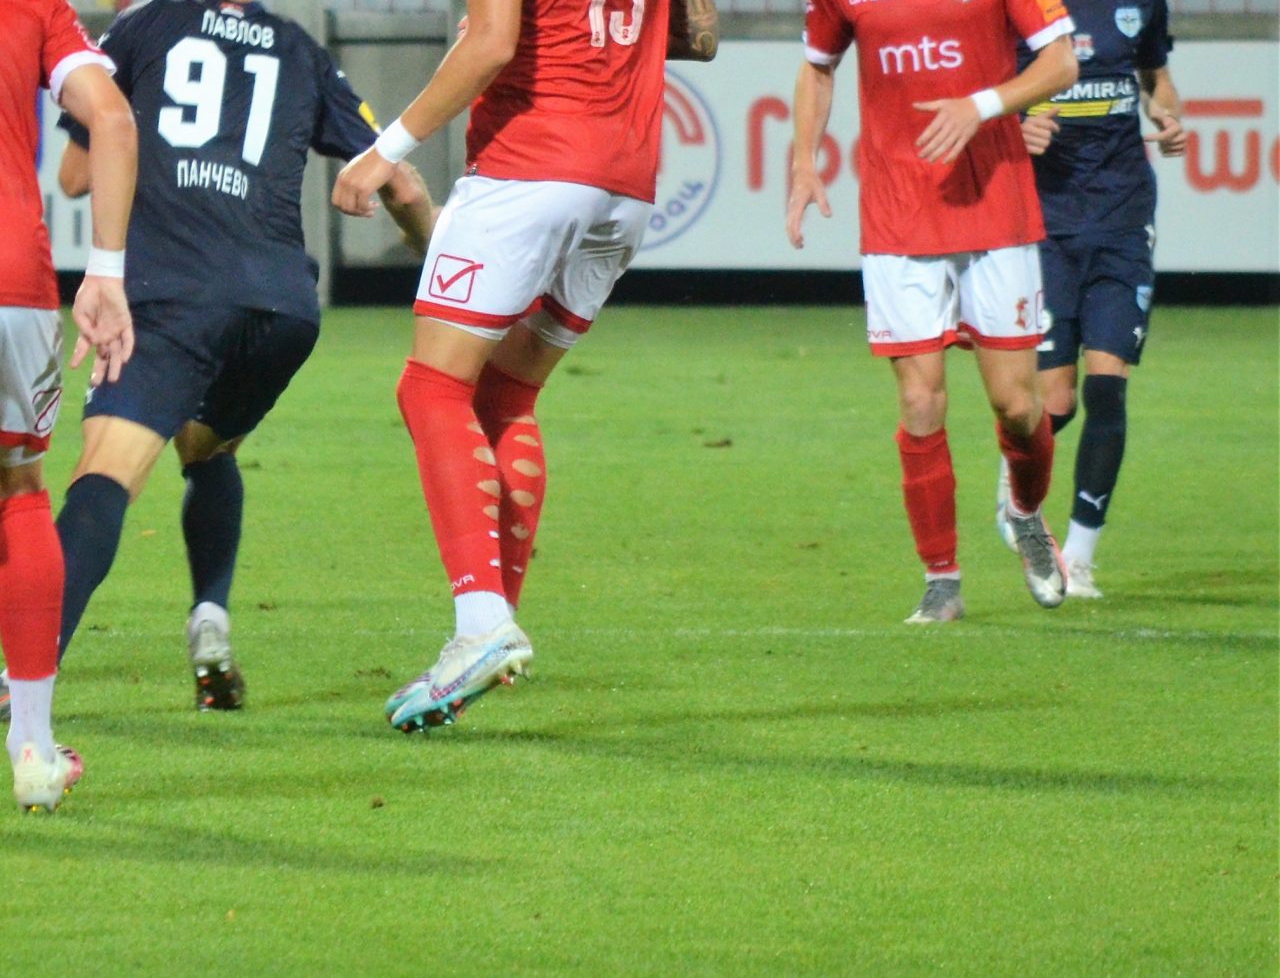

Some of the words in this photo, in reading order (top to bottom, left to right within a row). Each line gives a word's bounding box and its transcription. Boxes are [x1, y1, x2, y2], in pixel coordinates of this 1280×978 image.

[201, 9, 275, 49] ПАВЛОВ
[879, 36, 963, 74] mts
[157, 36, 280, 167] 91
[177, 159, 248, 200] ПАНЧЕВО
